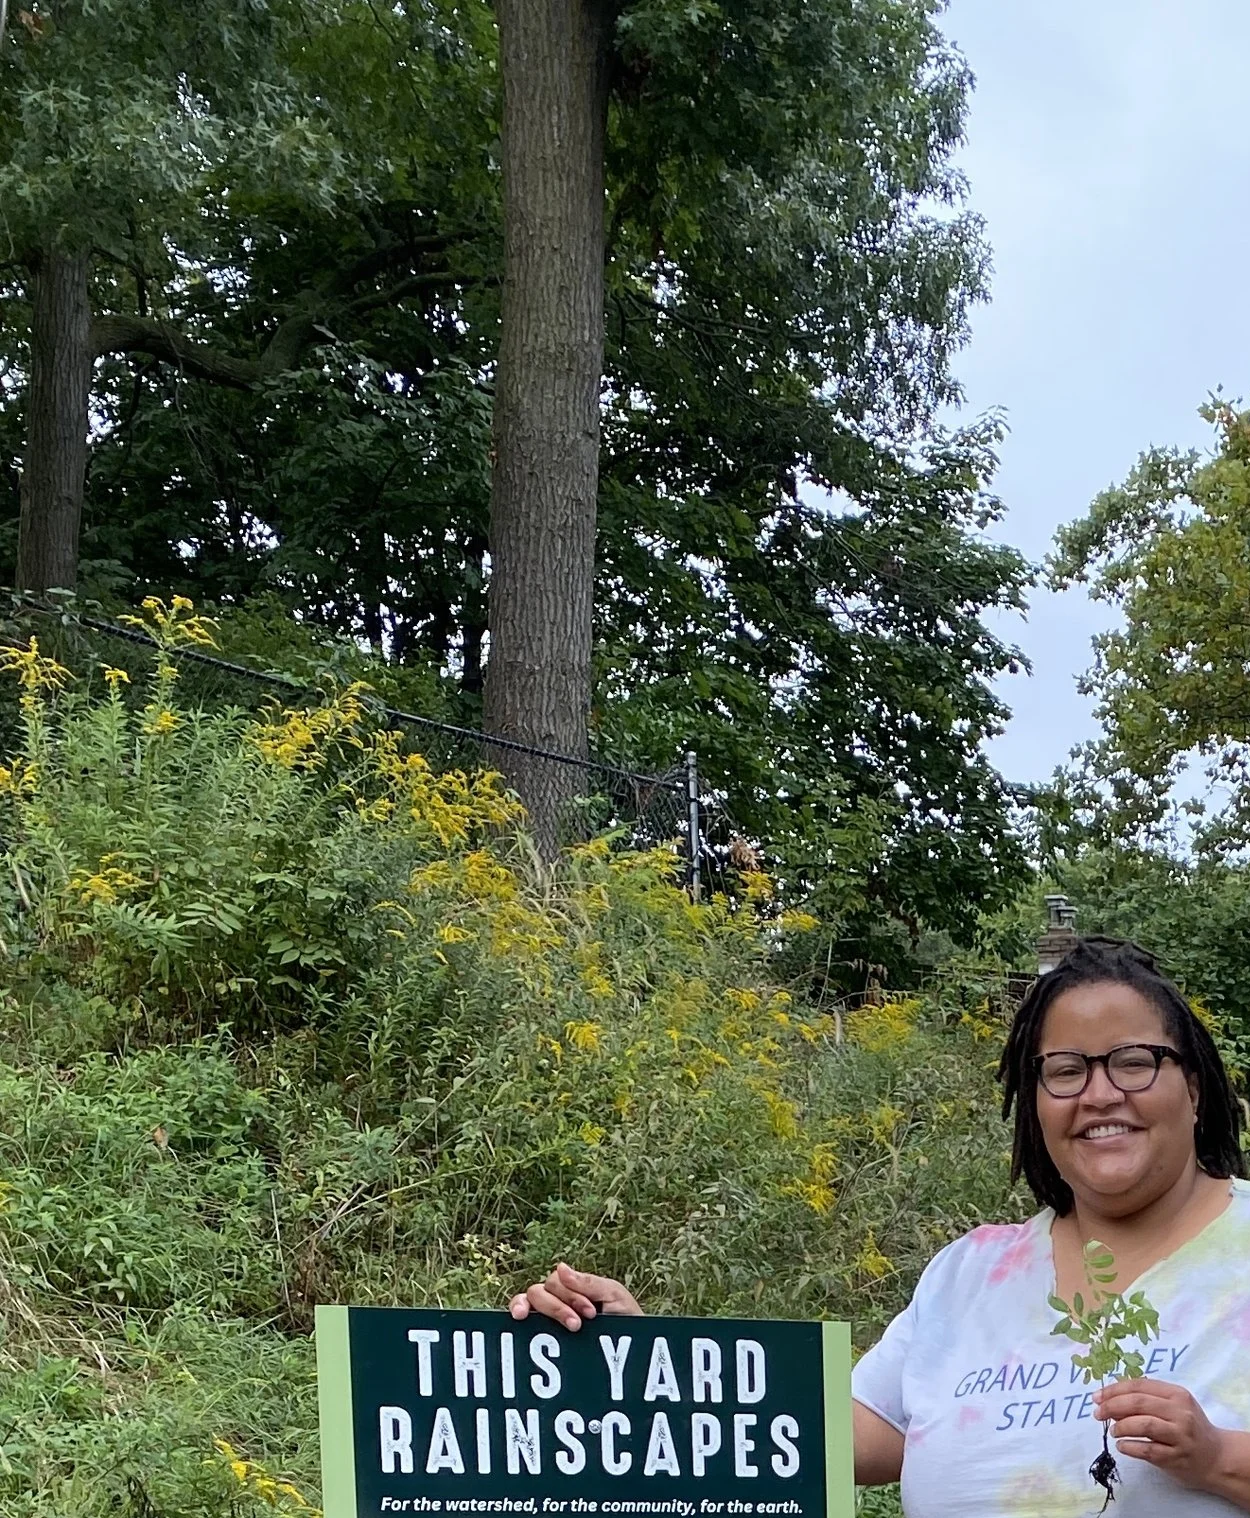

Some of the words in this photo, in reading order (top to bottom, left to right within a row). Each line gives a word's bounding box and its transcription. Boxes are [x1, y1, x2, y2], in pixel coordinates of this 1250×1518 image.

[407, 1328, 562, 1400] THIS
[598, 1334, 767, 1404] YARD
[954, 1362, 1058, 1398] GRAND
[995, 1391, 1094, 1431] STATE
[378, 1404, 801, 1479] RAINSCAPES
[380, 1496, 411, 1511] For
[413, 1496, 442, 1512] the
[445, 1497, 538, 1515] watershed,
[542, 1497, 568, 1512] for
[570, 1497, 598, 1512] the
[601, 1498, 696, 1517] community,
[700, 1498, 725, 1513] for
[726, 1499, 754, 1514] the
[756, 1499, 803, 1514] earth.
